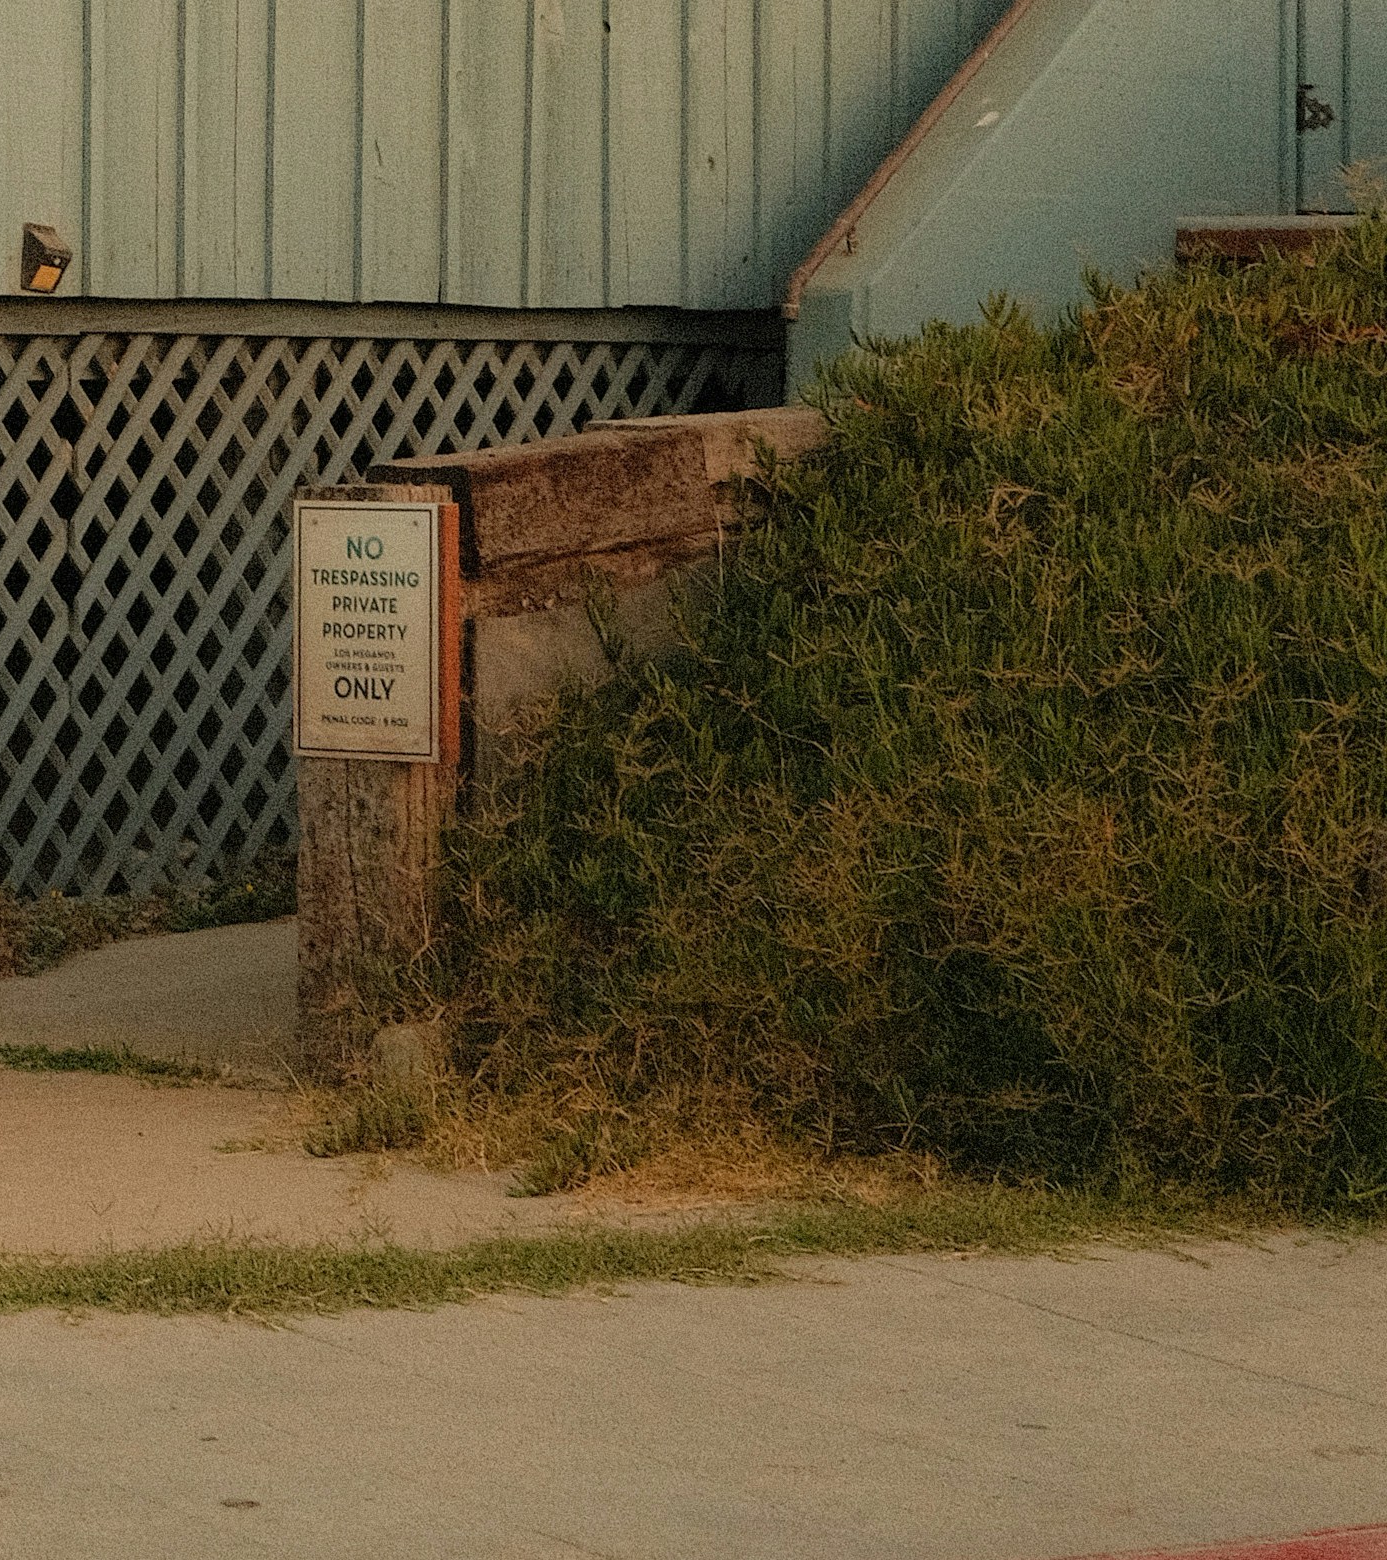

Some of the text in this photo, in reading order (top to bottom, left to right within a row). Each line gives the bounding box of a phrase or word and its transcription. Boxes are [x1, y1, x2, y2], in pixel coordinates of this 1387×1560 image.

[347, 536, 383, 560] NO
[311, 568, 420, 588] TRESPASSING
[332, 596, 397, 614] PRIVATE
[323, 622, 407, 640] PROPERTY
[325, 661, 363, 672] OWNERS
[334, 676, 395, 700] ONLY
